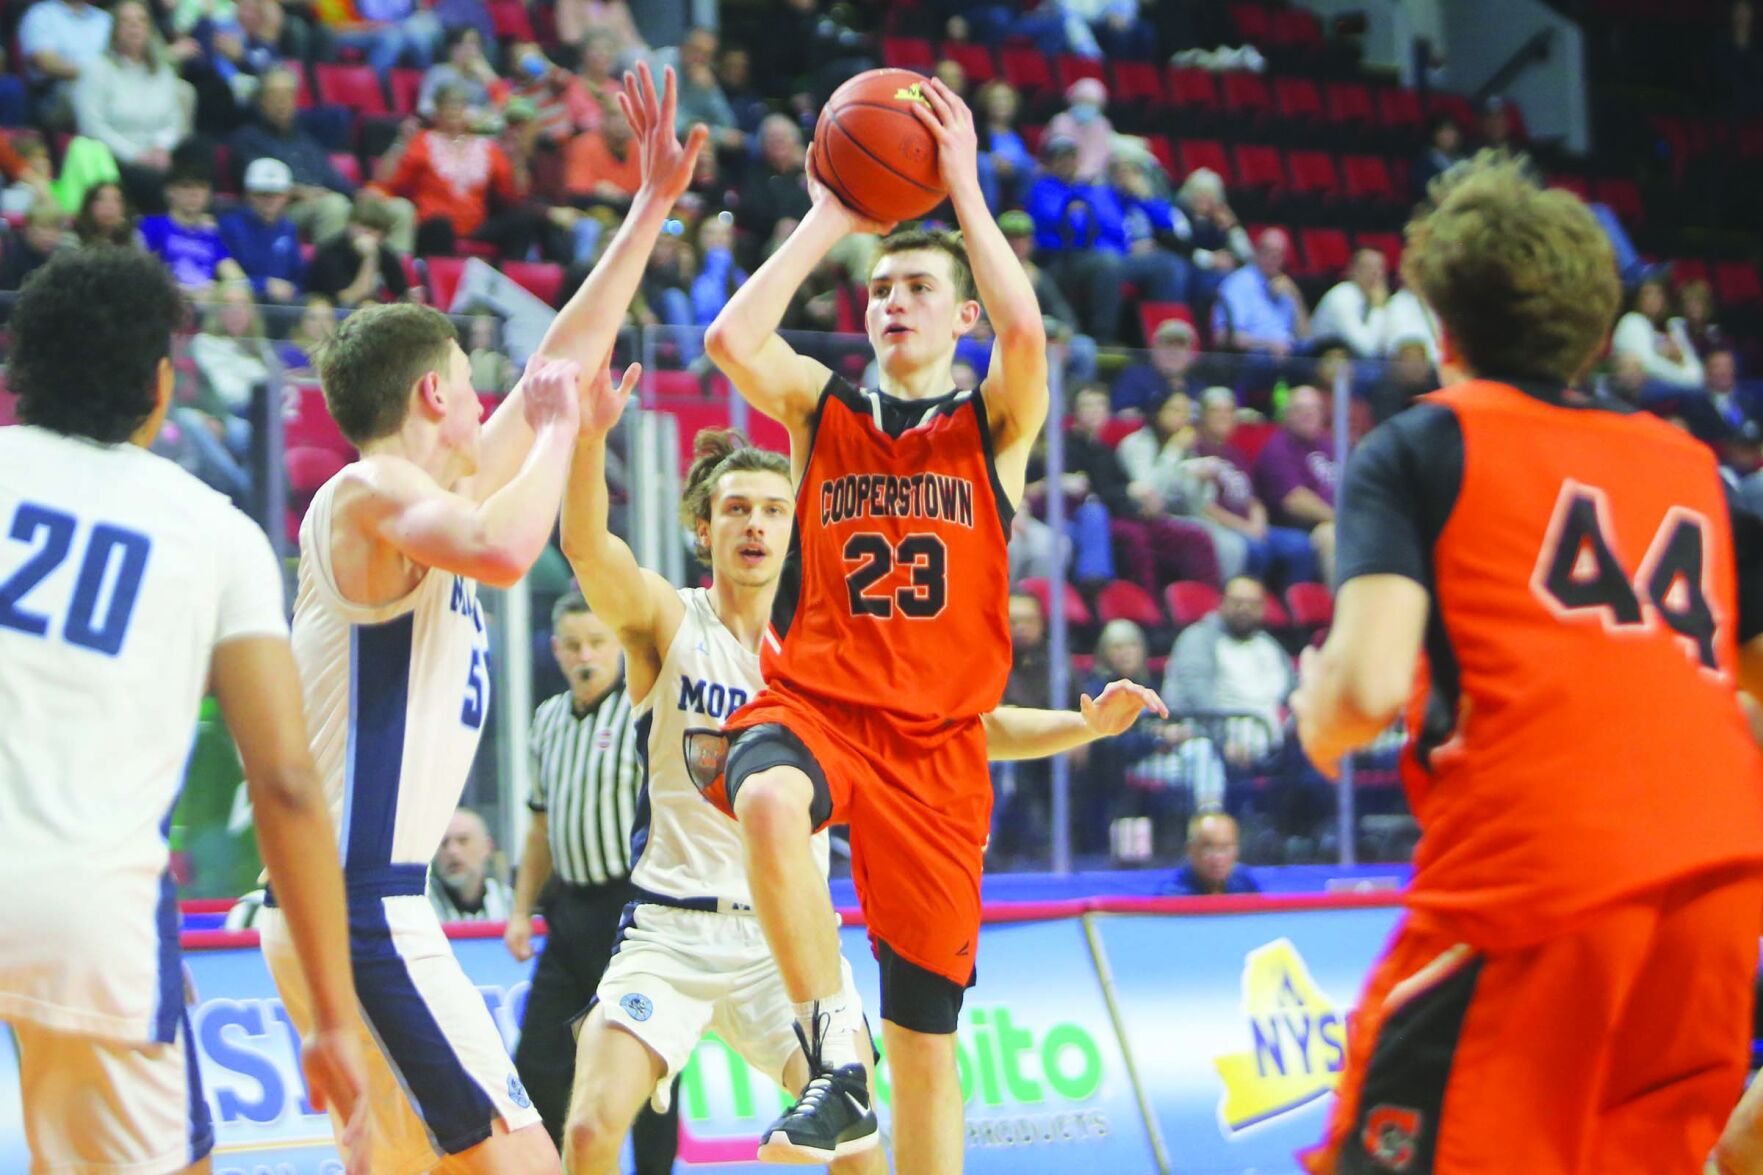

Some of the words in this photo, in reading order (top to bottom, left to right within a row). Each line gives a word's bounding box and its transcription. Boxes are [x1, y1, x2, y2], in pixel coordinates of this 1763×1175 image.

[820, 472, 974, 529] COOPERSTOWN
[0, 501, 153, 658] 20
[842, 532, 948, 619] 23
[1529, 477, 1727, 682] 44
